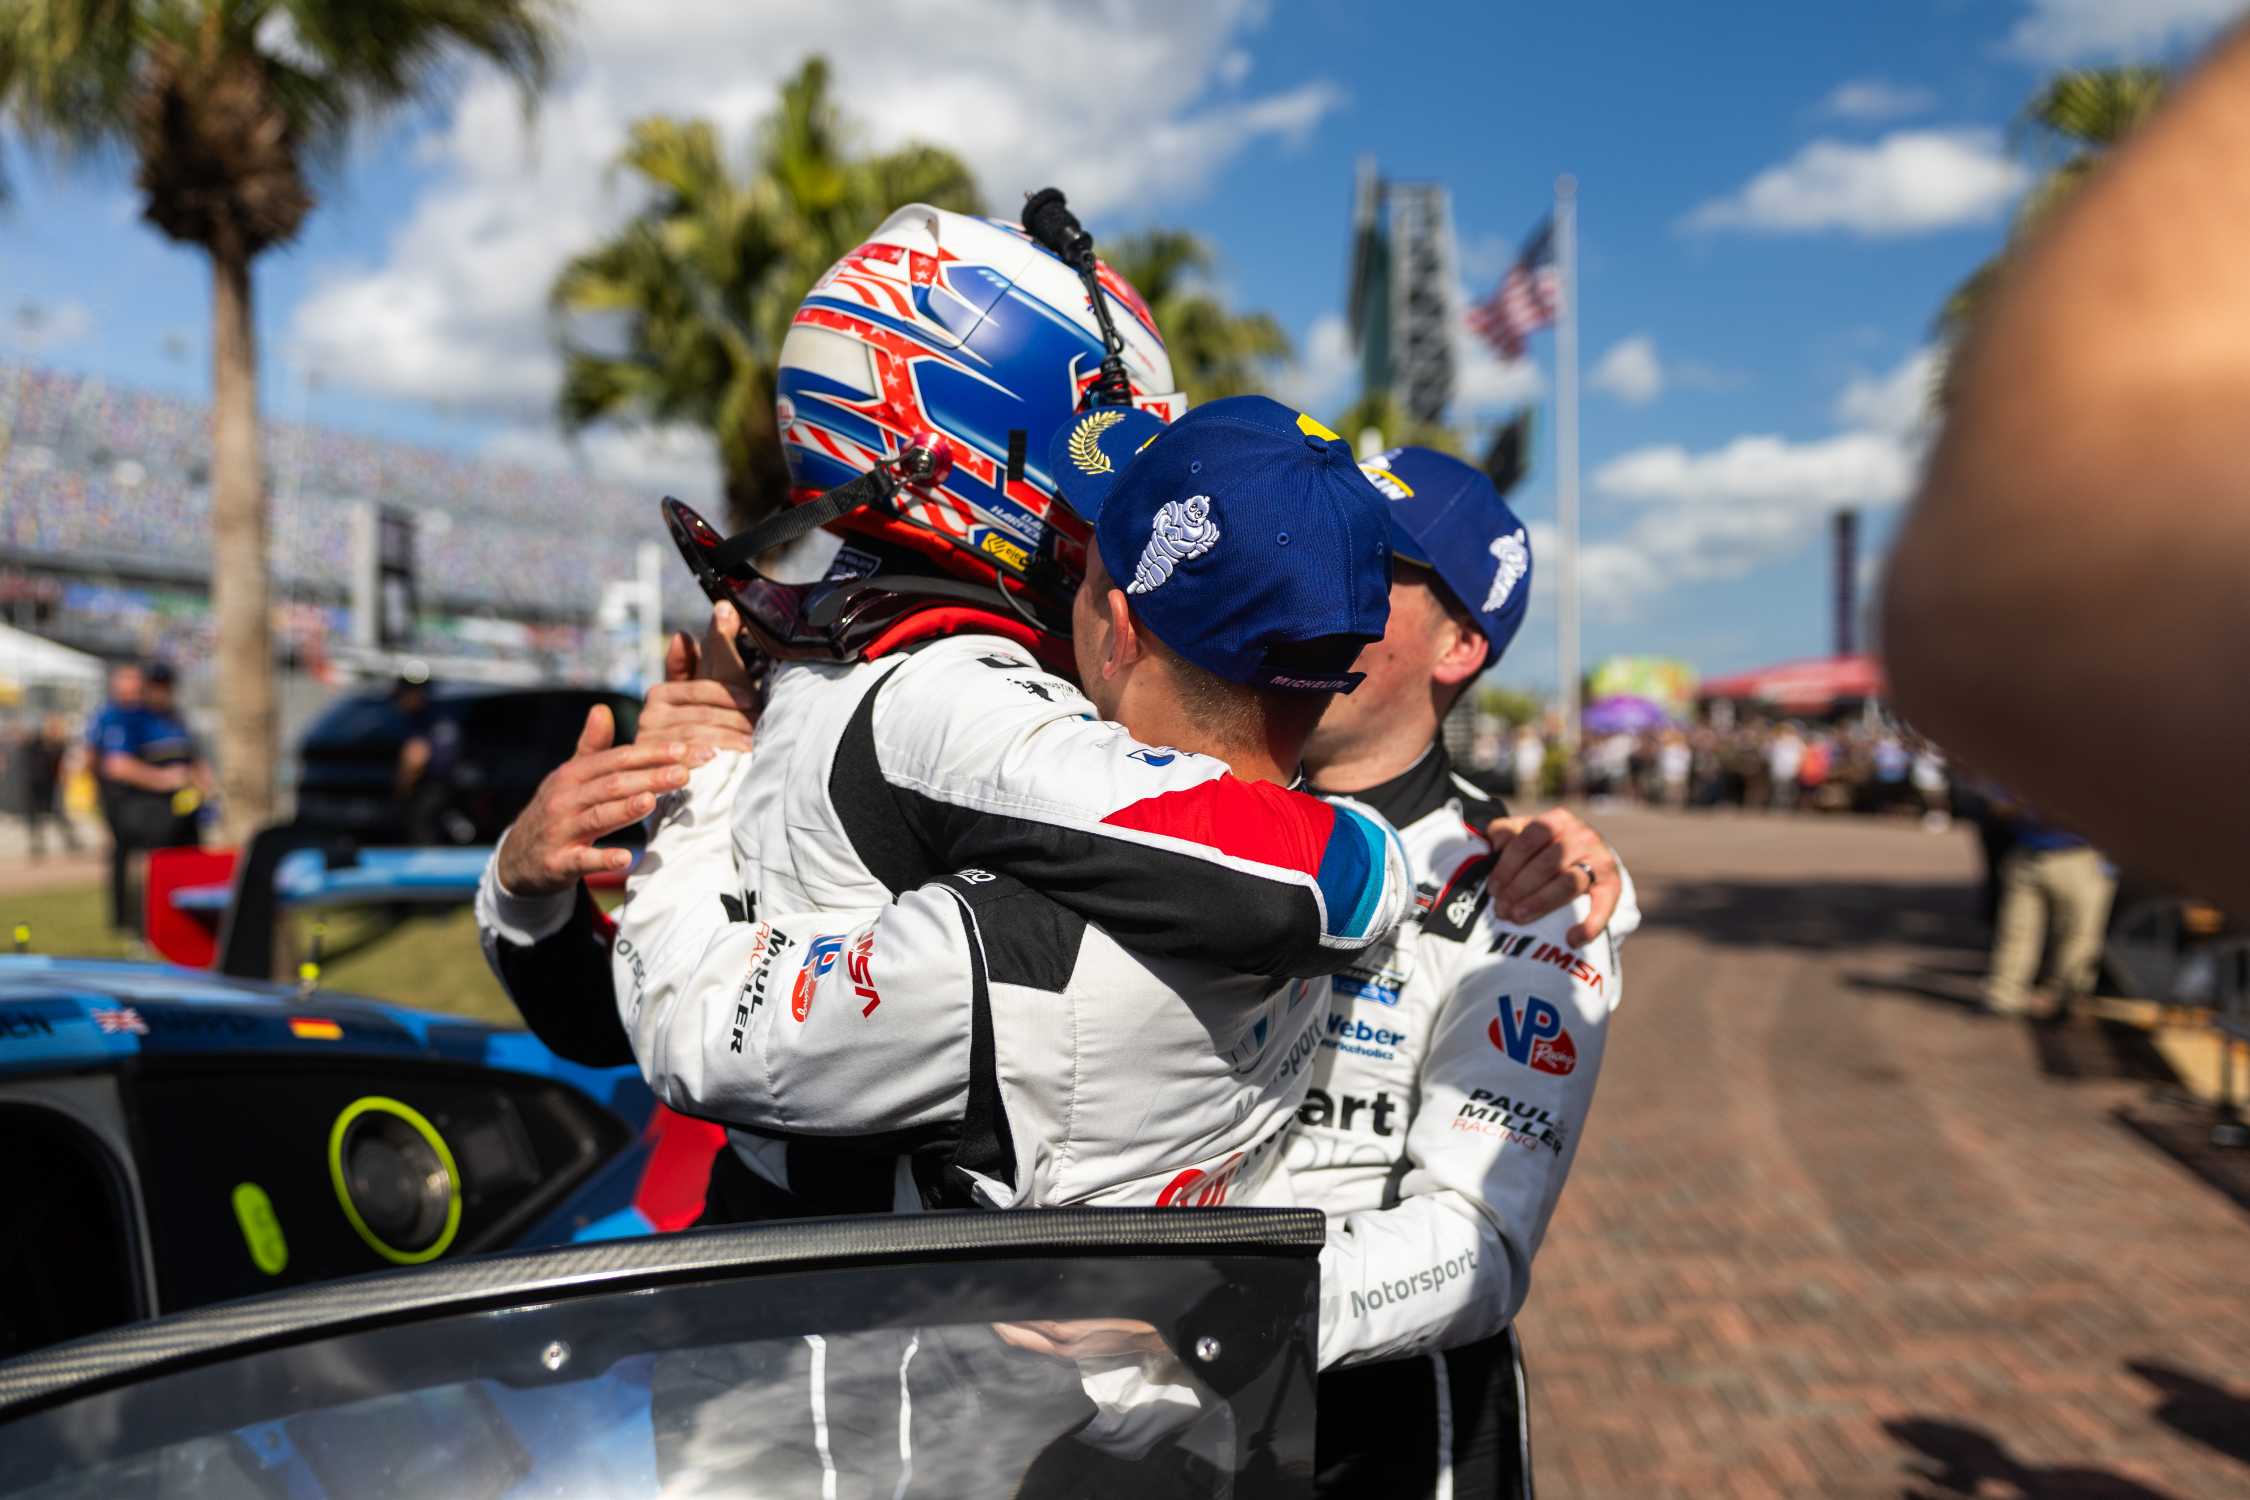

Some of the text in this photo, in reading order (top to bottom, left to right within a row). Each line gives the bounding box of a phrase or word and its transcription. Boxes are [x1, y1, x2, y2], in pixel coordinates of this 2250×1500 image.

[1269, 675, 1350, 690] MICHELIN
[1531, 942, 1604, 996] IMSA
[1328, 1012, 1406, 1046] Weber
[1498, 994, 1561, 1066] VP
[1532, 1042, 1576, 1073] Racing
[1469, 1088, 1553, 1127] PAUL
[1450, 1118, 1539, 1152] RACING
[1458, 1103, 1563, 1157] MILLER
